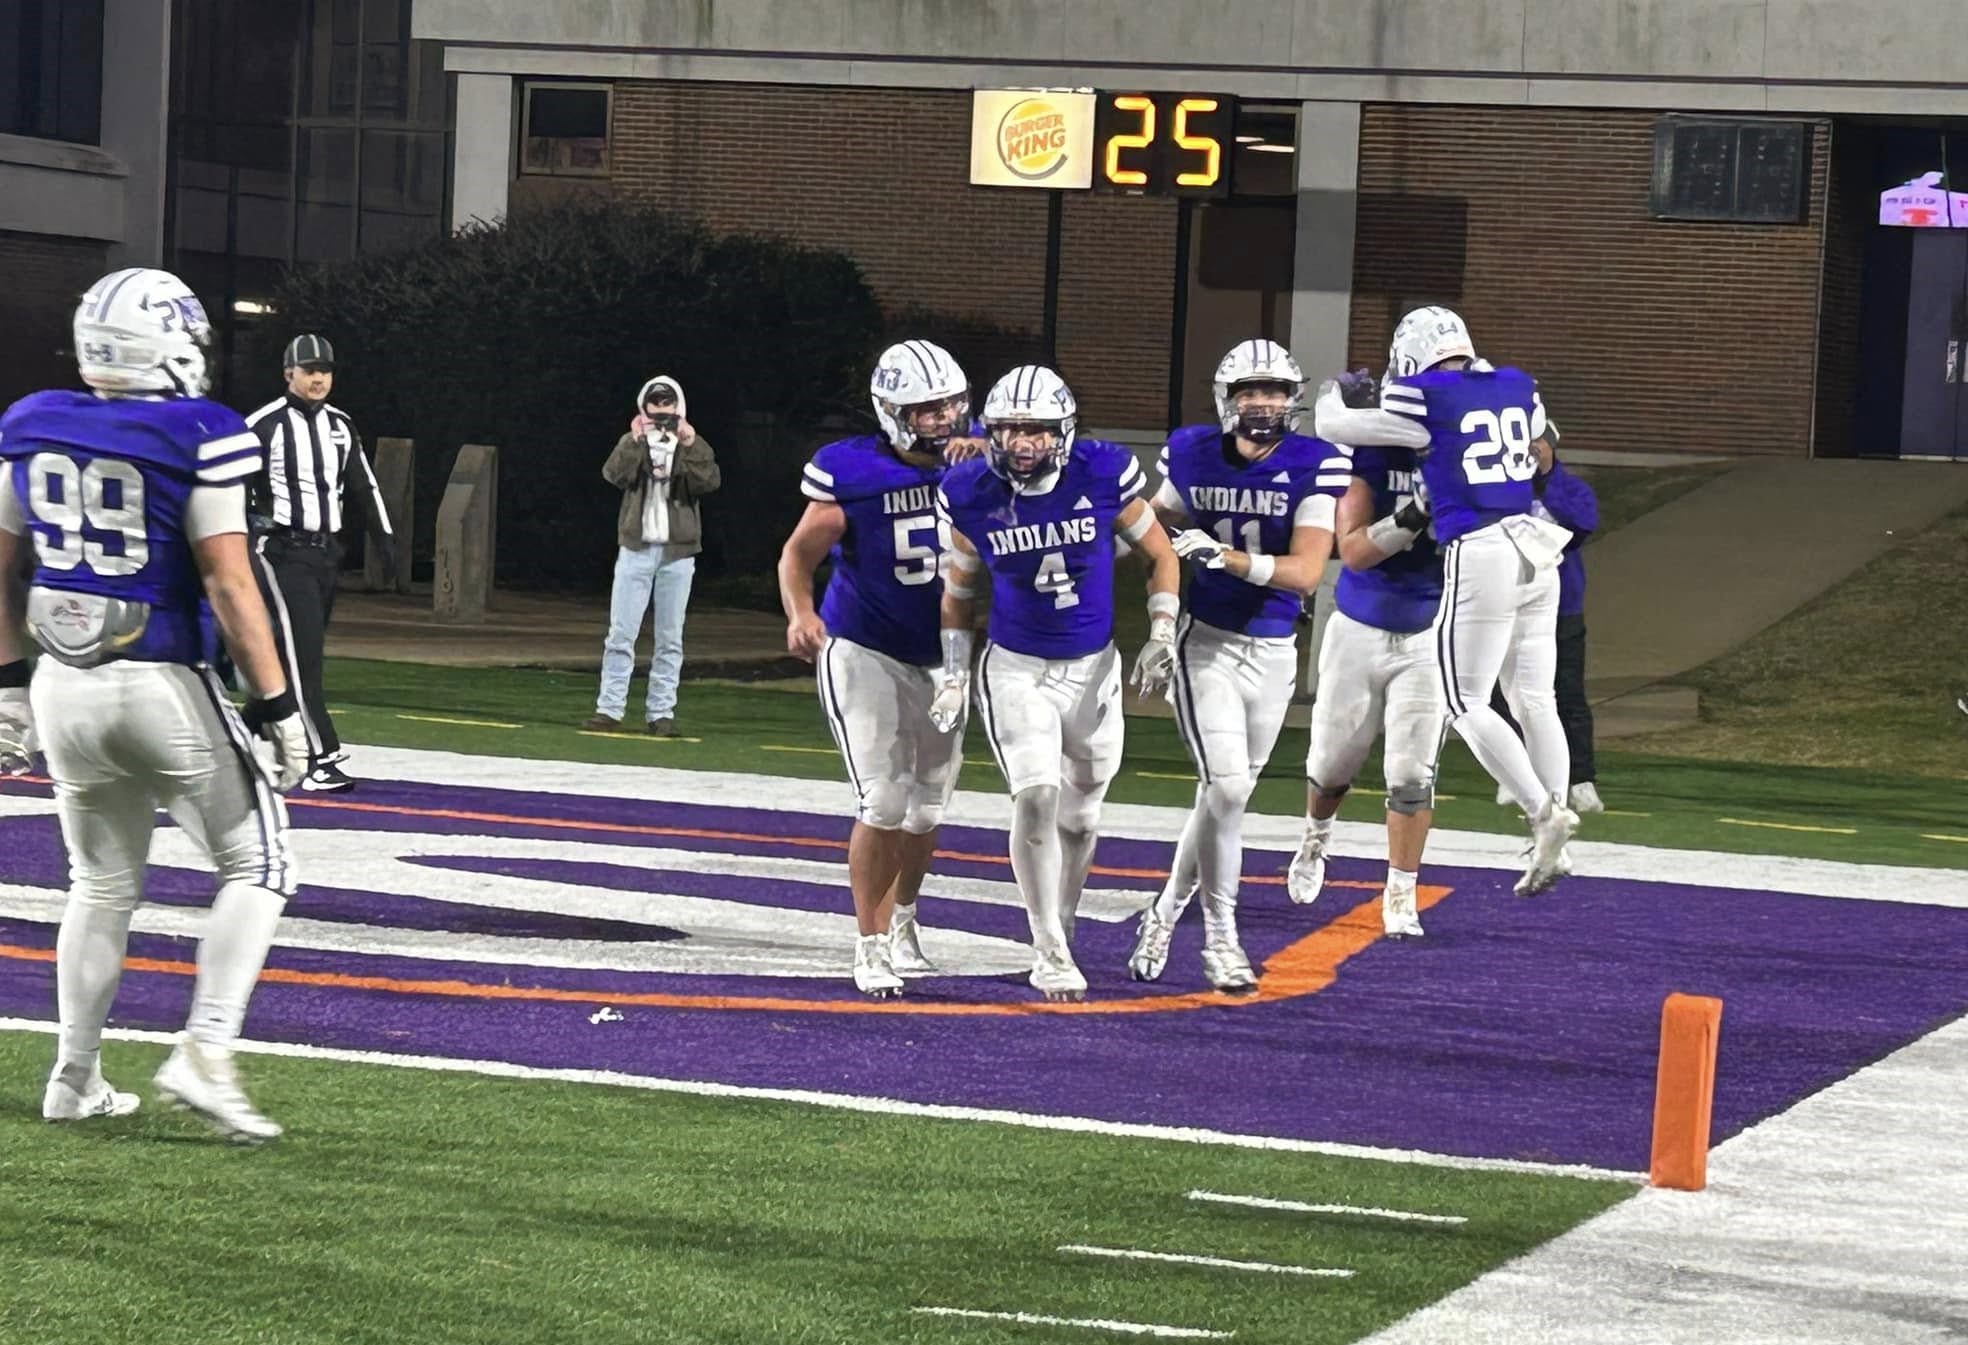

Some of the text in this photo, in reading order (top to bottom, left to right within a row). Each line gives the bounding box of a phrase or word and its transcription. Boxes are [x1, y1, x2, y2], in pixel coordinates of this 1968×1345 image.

[1005, 114, 1064, 142] BURGER
[1007, 128, 1066, 162] KING
[1106, 96, 1221, 187] 25
[1460, 406, 1538, 484] 28
[28, 452, 149, 577] 99
[883, 485, 938, 514] INDI
[1189, 486, 1289, 516] INDIANS
[986, 516, 1096, 556] INDIANS
[1213, 517, 1262, 556] 11
[1034, 551, 1080, 610] 4
